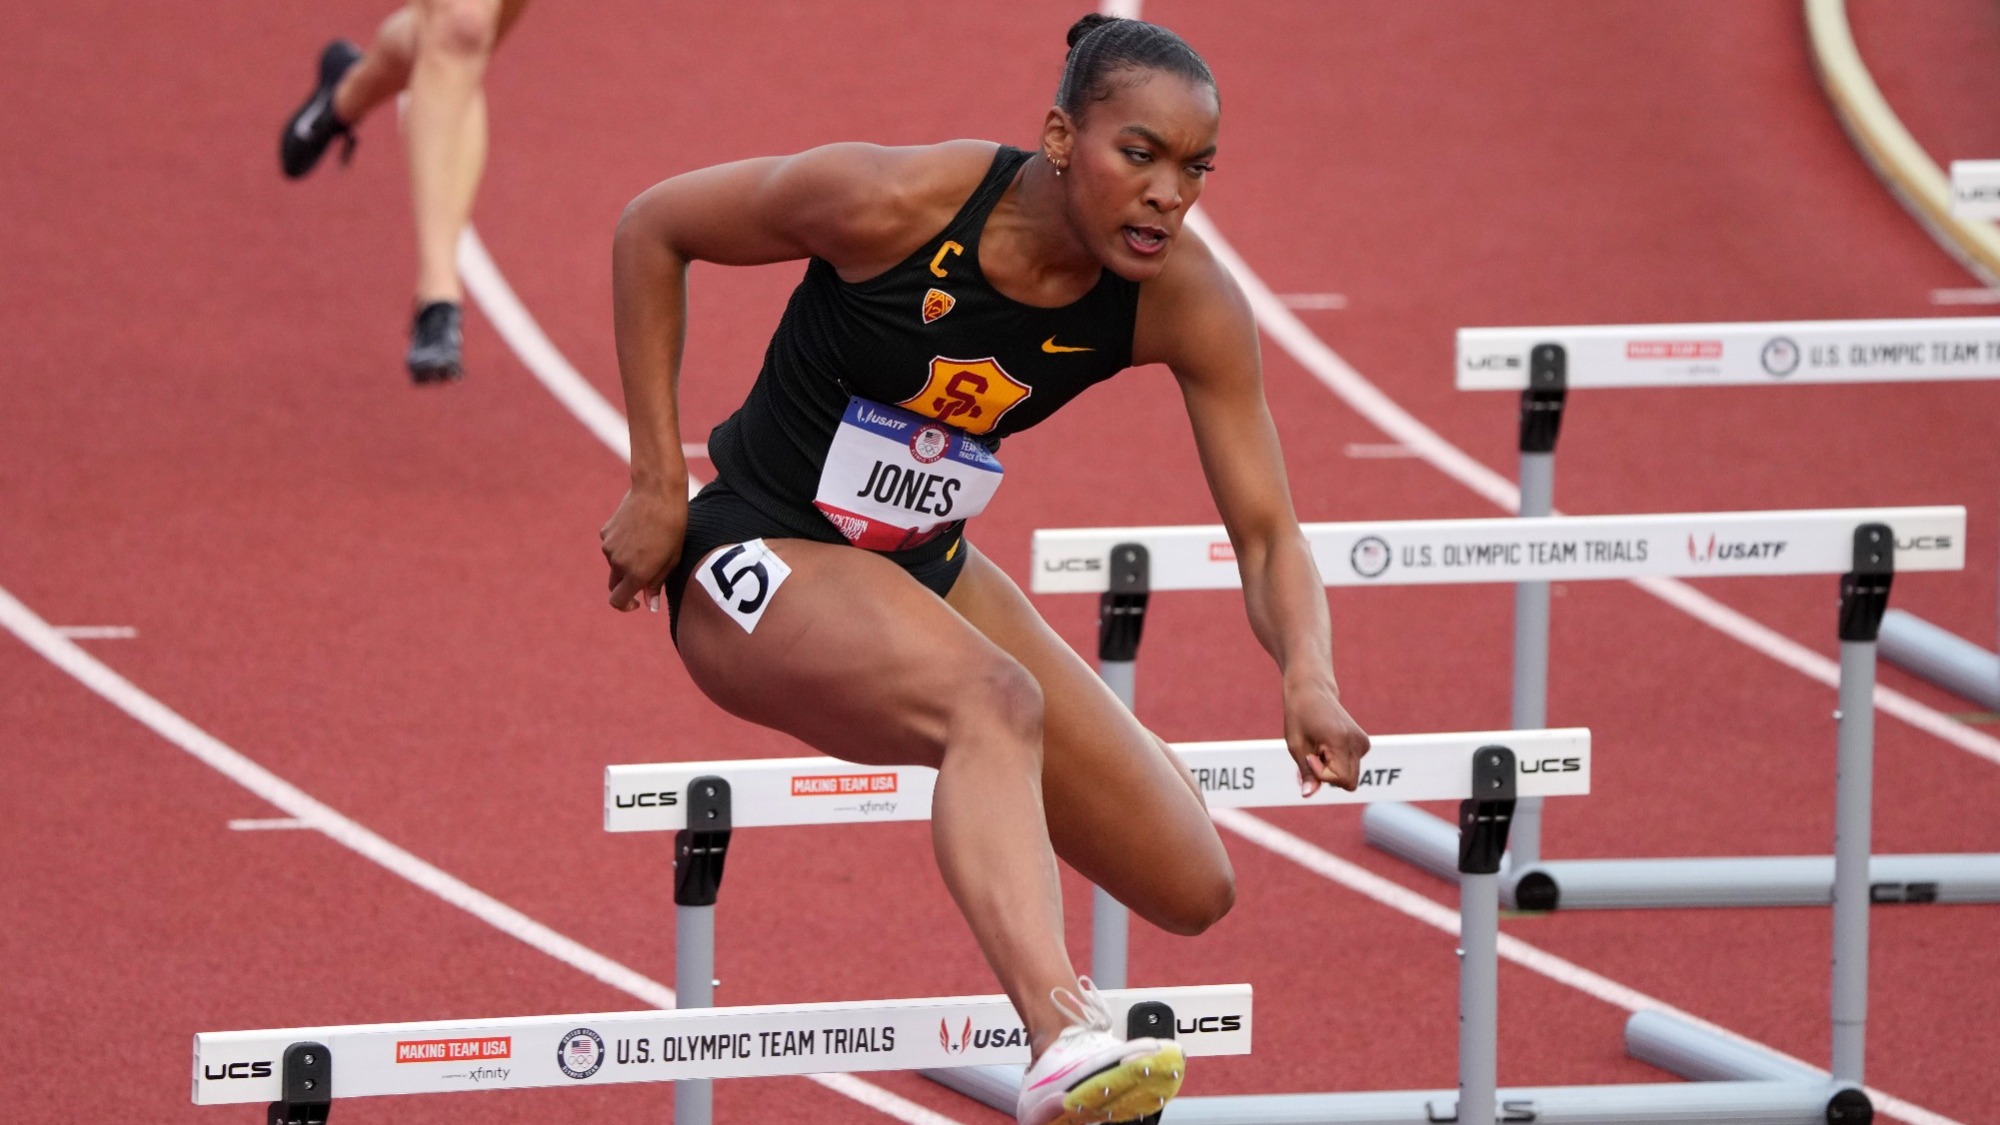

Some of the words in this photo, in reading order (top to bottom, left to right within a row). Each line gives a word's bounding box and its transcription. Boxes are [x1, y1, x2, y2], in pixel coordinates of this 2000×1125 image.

[930, 241, 964, 278] C
[1467, 355, 1521, 369] UCS
[1809, 346, 1841, 367] U.S.
[1850, 342, 1925, 366] OLYMPIC
[1931, 341, 1979, 363] TEAM
[871, 414, 908, 430] USATF
[857, 460, 961, 517] JONES
[820, 509, 869, 533] RACKTOWN
[1718, 541, 1788, 560] USATF
[1894, 535, 1952, 550] UCS
[1402, 545, 1436, 568] U.S.
[1443, 543, 1521, 566] OLYMPIC
[1528, 541, 1577, 564] TEAM
[1585, 539, 1648, 563] TRIALS
[1044, 557, 1101, 572] UCS
[710, 544, 769, 614] 5
[1520, 757, 1581, 774] UCS
[793, 778, 838, 793] MAKING
[839, 776, 869, 792] TEAM
[870, 775, 895, 791] USA
[1190, 767, 1255, 791] TRIALS
[1358, 768, 1402, 787] ATF
[616, 791, 678, 808] UCS
[859, 800, 897, 815] xfinity
[1869, 882, 1938, 903] CS
[1176, 1015, 1241, 1034] UCS
[616, 1038, 655, 1064] U.S.
[663, 1033, 751, 1062] OLYMPIC
[759, 1029, 815, 1057] TEAM
[822, 1026, 895, 1054] TRIALS
[974, 1027, 1031, 1049] USAT
[399, 1043, 446, 1060] MAKING
[448, 1041, 479, 1057] TEAM
[482, 1040, 508, 1056] USA
[204, 1060, 274, 1080] UCS
[468, 1066, 511, 1082] xfinity
[1425, 1101, 1537, 1123] US
